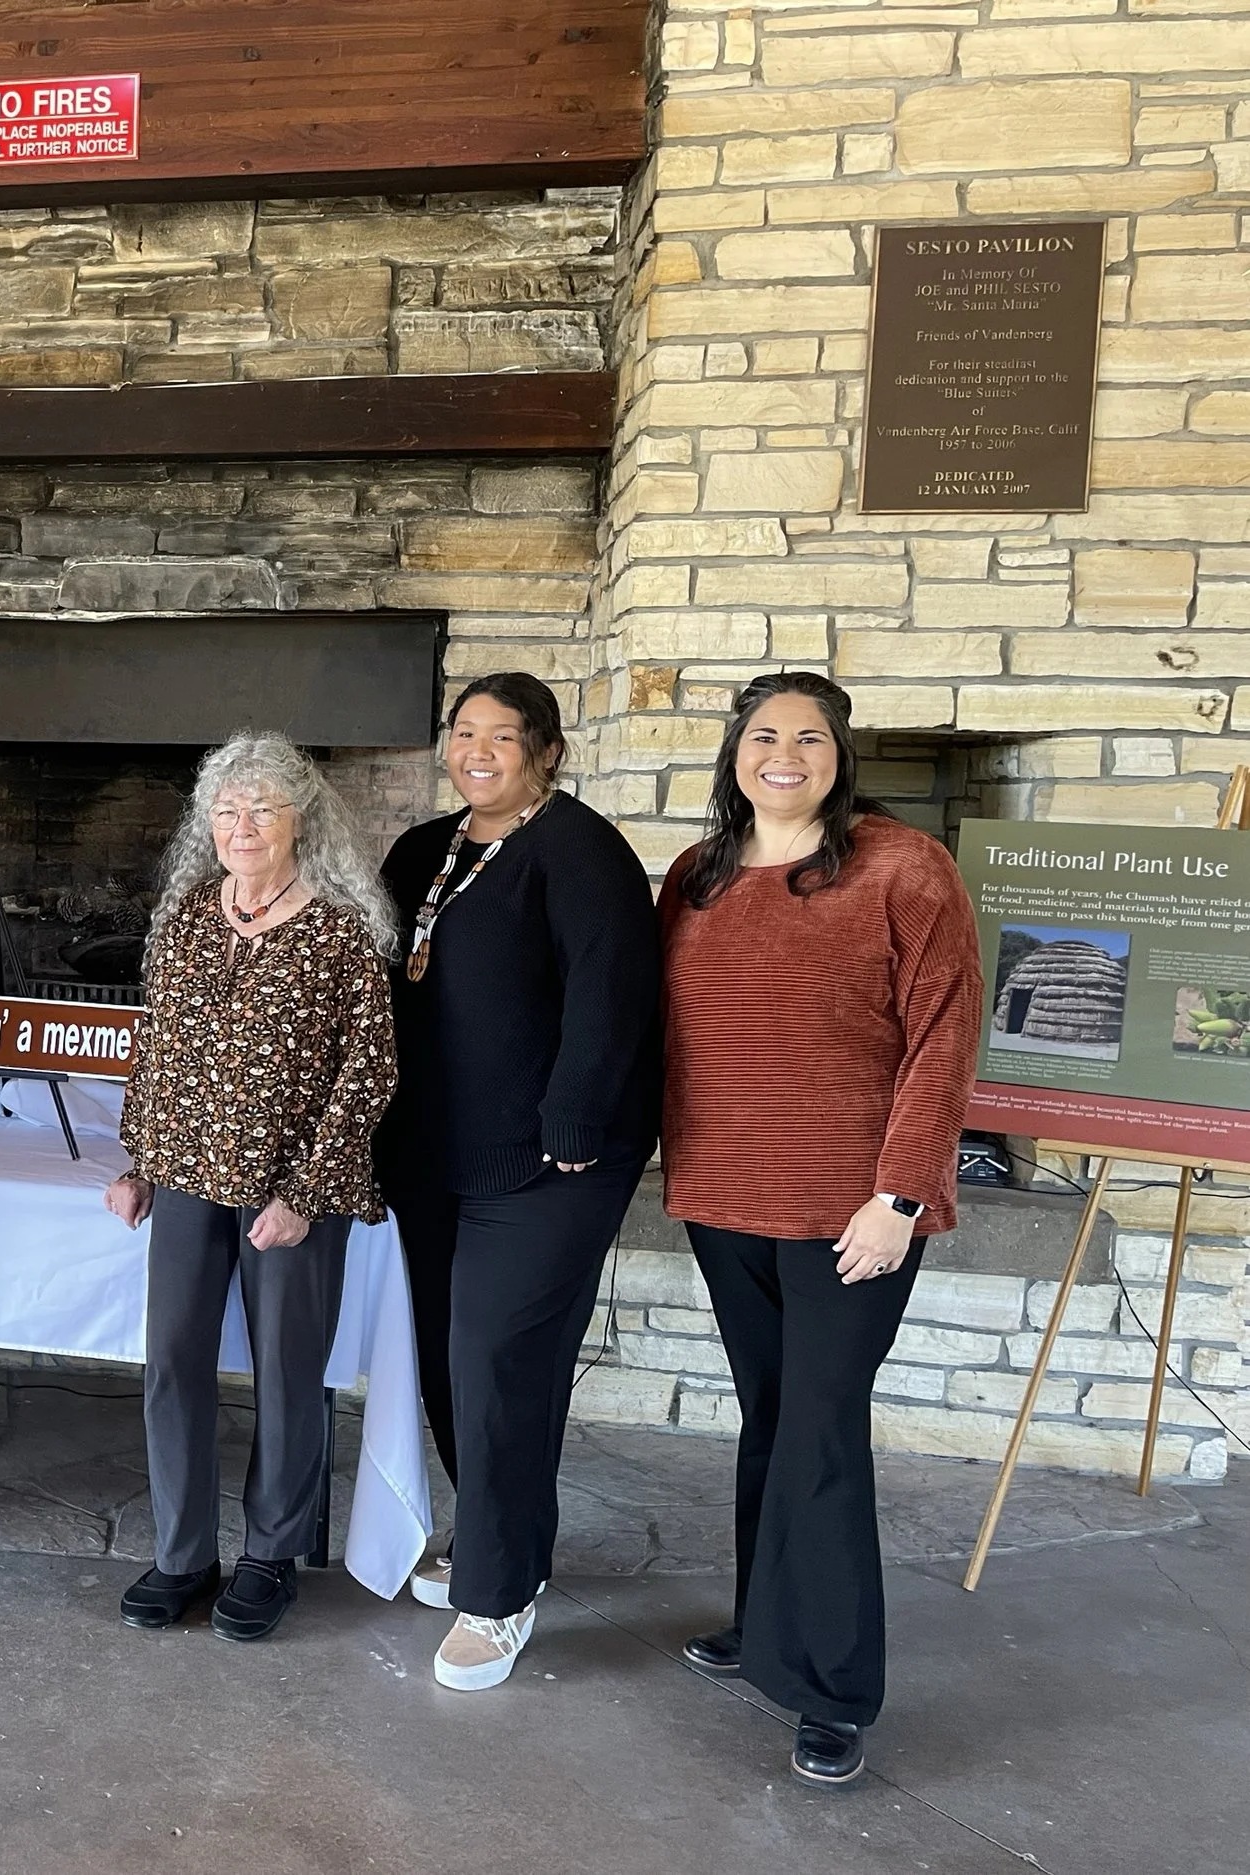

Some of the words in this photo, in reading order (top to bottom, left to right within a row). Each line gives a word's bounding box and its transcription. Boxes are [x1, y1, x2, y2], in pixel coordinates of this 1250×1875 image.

[33, 86, 112, 116] FIRES
[43, 120, 129, 138] INOPERABLE
[9, 141, 71, 157] FURTHER
[77, 138, 128, 154] NOTICE
[905, 239, 970, 255] SESTO
[978, 237, 1075, 254] PAVILION
[942, 269, 955, 280] In
[960, 267, 1015, 280] Memory
[1019, 266, 1037, 279] Of
[914, 284, 941, 297] JOE
[946, 284, 969, 296] and
[974, 283, 1008, 295] PHIL
[1014, 282, 1061, 294] SESTO
[962, 299, 997, 310] Santa
[916, 329, 960, 342] Friends
[964, 329, 979, 340] of
[982, 328, 1053, 342] Vandenberg
[929, 360, 949, 370] For
[953, 359, 980, 370] their
[984, 359, 1037, 369] steadfast
[895, 374, 956, 385] dedication
[960, 373, 981, 384] and
[986, 373, 1030, 386] support
[1035, 373, 1046, 383] to
[1050, 372, 1069, 383] the
[972, 405, 985, 416] of
[876, 425, 946, 438] Vandenberg
[951, 425, 970, 436] Air
[975, 425, 1008, 436] Force
[939, 439, 967, 450] 1957
[971, 440, 983, 450] to
[987, 439, 1016, 450] 2006
[934, 471, 1015, 482] DEDICATED
[918, 486, 930, 495] 12
[934, 485, 997, 495] JANUARY
[1003, 484, 1031, 494] 2007
[985, 846, 1105, 872] Traditional
[1114, 852, 1173, 875] Plant
[1182, 856, 1230, 878] Use
[982, 883, 999, 892] For
[1002, 885, 1055, 896] thousands
[1057, 888, 1070, 896] of
[1071, 890, 1103, 899] years,
[1105, 891, 1123, 900] the
[1125, 891, 1178, 904] Chumash
[1181, 895, 1207, 905] have
[1210, 898, 1241, 907] relied
[981, 894, 996, 903] for
[998, 895, 1026, 905] food,
[1028, 898, 1079, 909] medicine,
[1081, 901, 1102, 910] and
[1105, 902, 1155, 913] materials
[1158, 904, 1169, 914] to
[1172, 906, 1201, 916] build
[1204, 908, 1232, 918] their
[1234, 910, 1250, 919] ho
[980, 904, 1006, 916] They
[1008, 907, 1054, 918] continue
[1056, 910, 1068, 918] to
[1070, 912, 1093, 921] pass
[1096, 912, 1117, 921] this
[1120, 914, 1178, 928] knowledge
[1181, 918, 1207, 928] from
[1210, 921, 1231, 930] one
[17, 1020, 32, 1052] a
